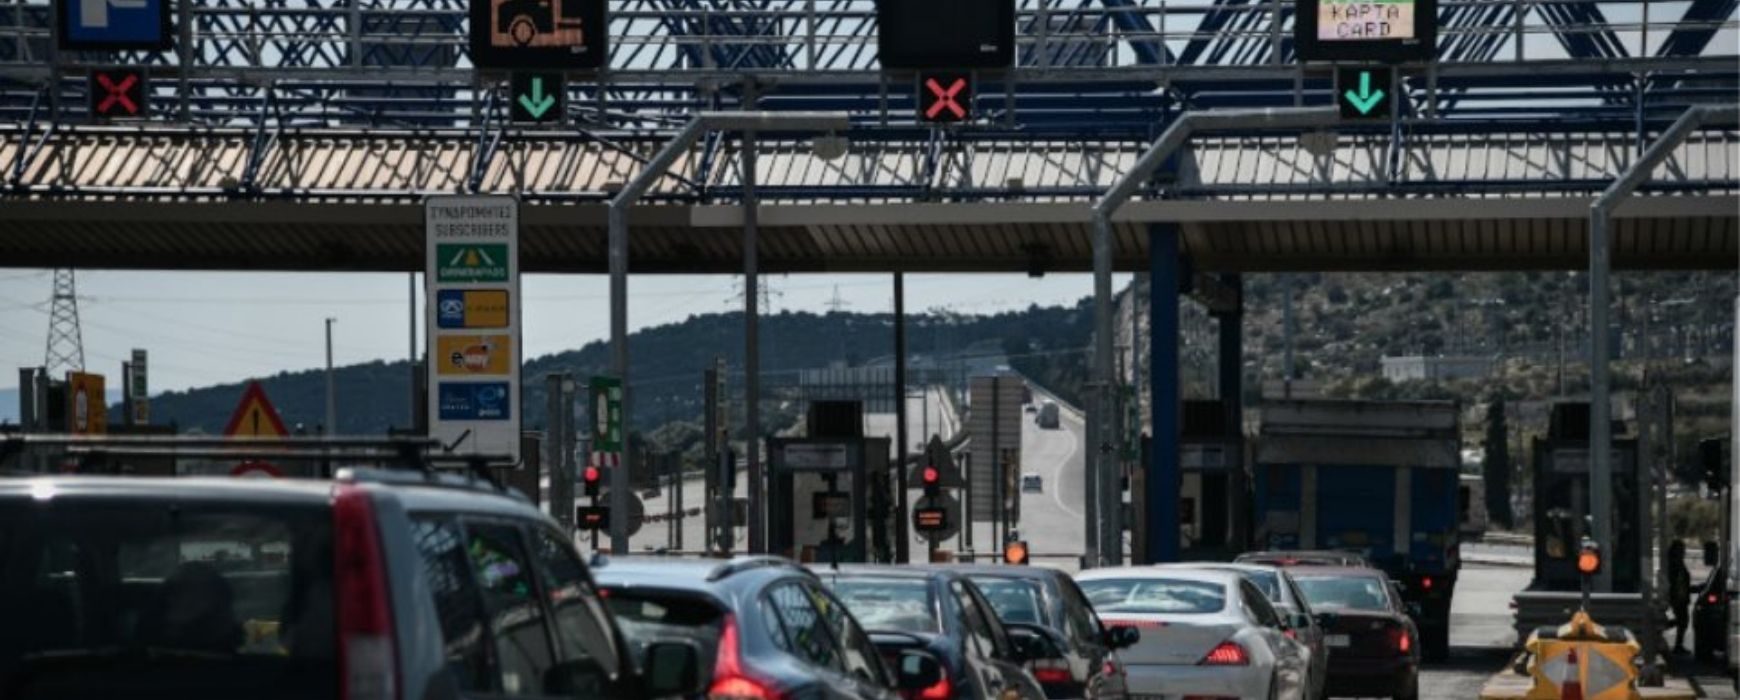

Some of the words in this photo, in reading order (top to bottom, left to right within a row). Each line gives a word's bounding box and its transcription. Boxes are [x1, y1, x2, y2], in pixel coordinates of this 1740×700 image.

[1332, 3, 1400, 20] ΚΑΡΤΑ
[1336, 21, 1391, 38] CARD
[435, 223, 510, 237] SUBSCRIBERS
